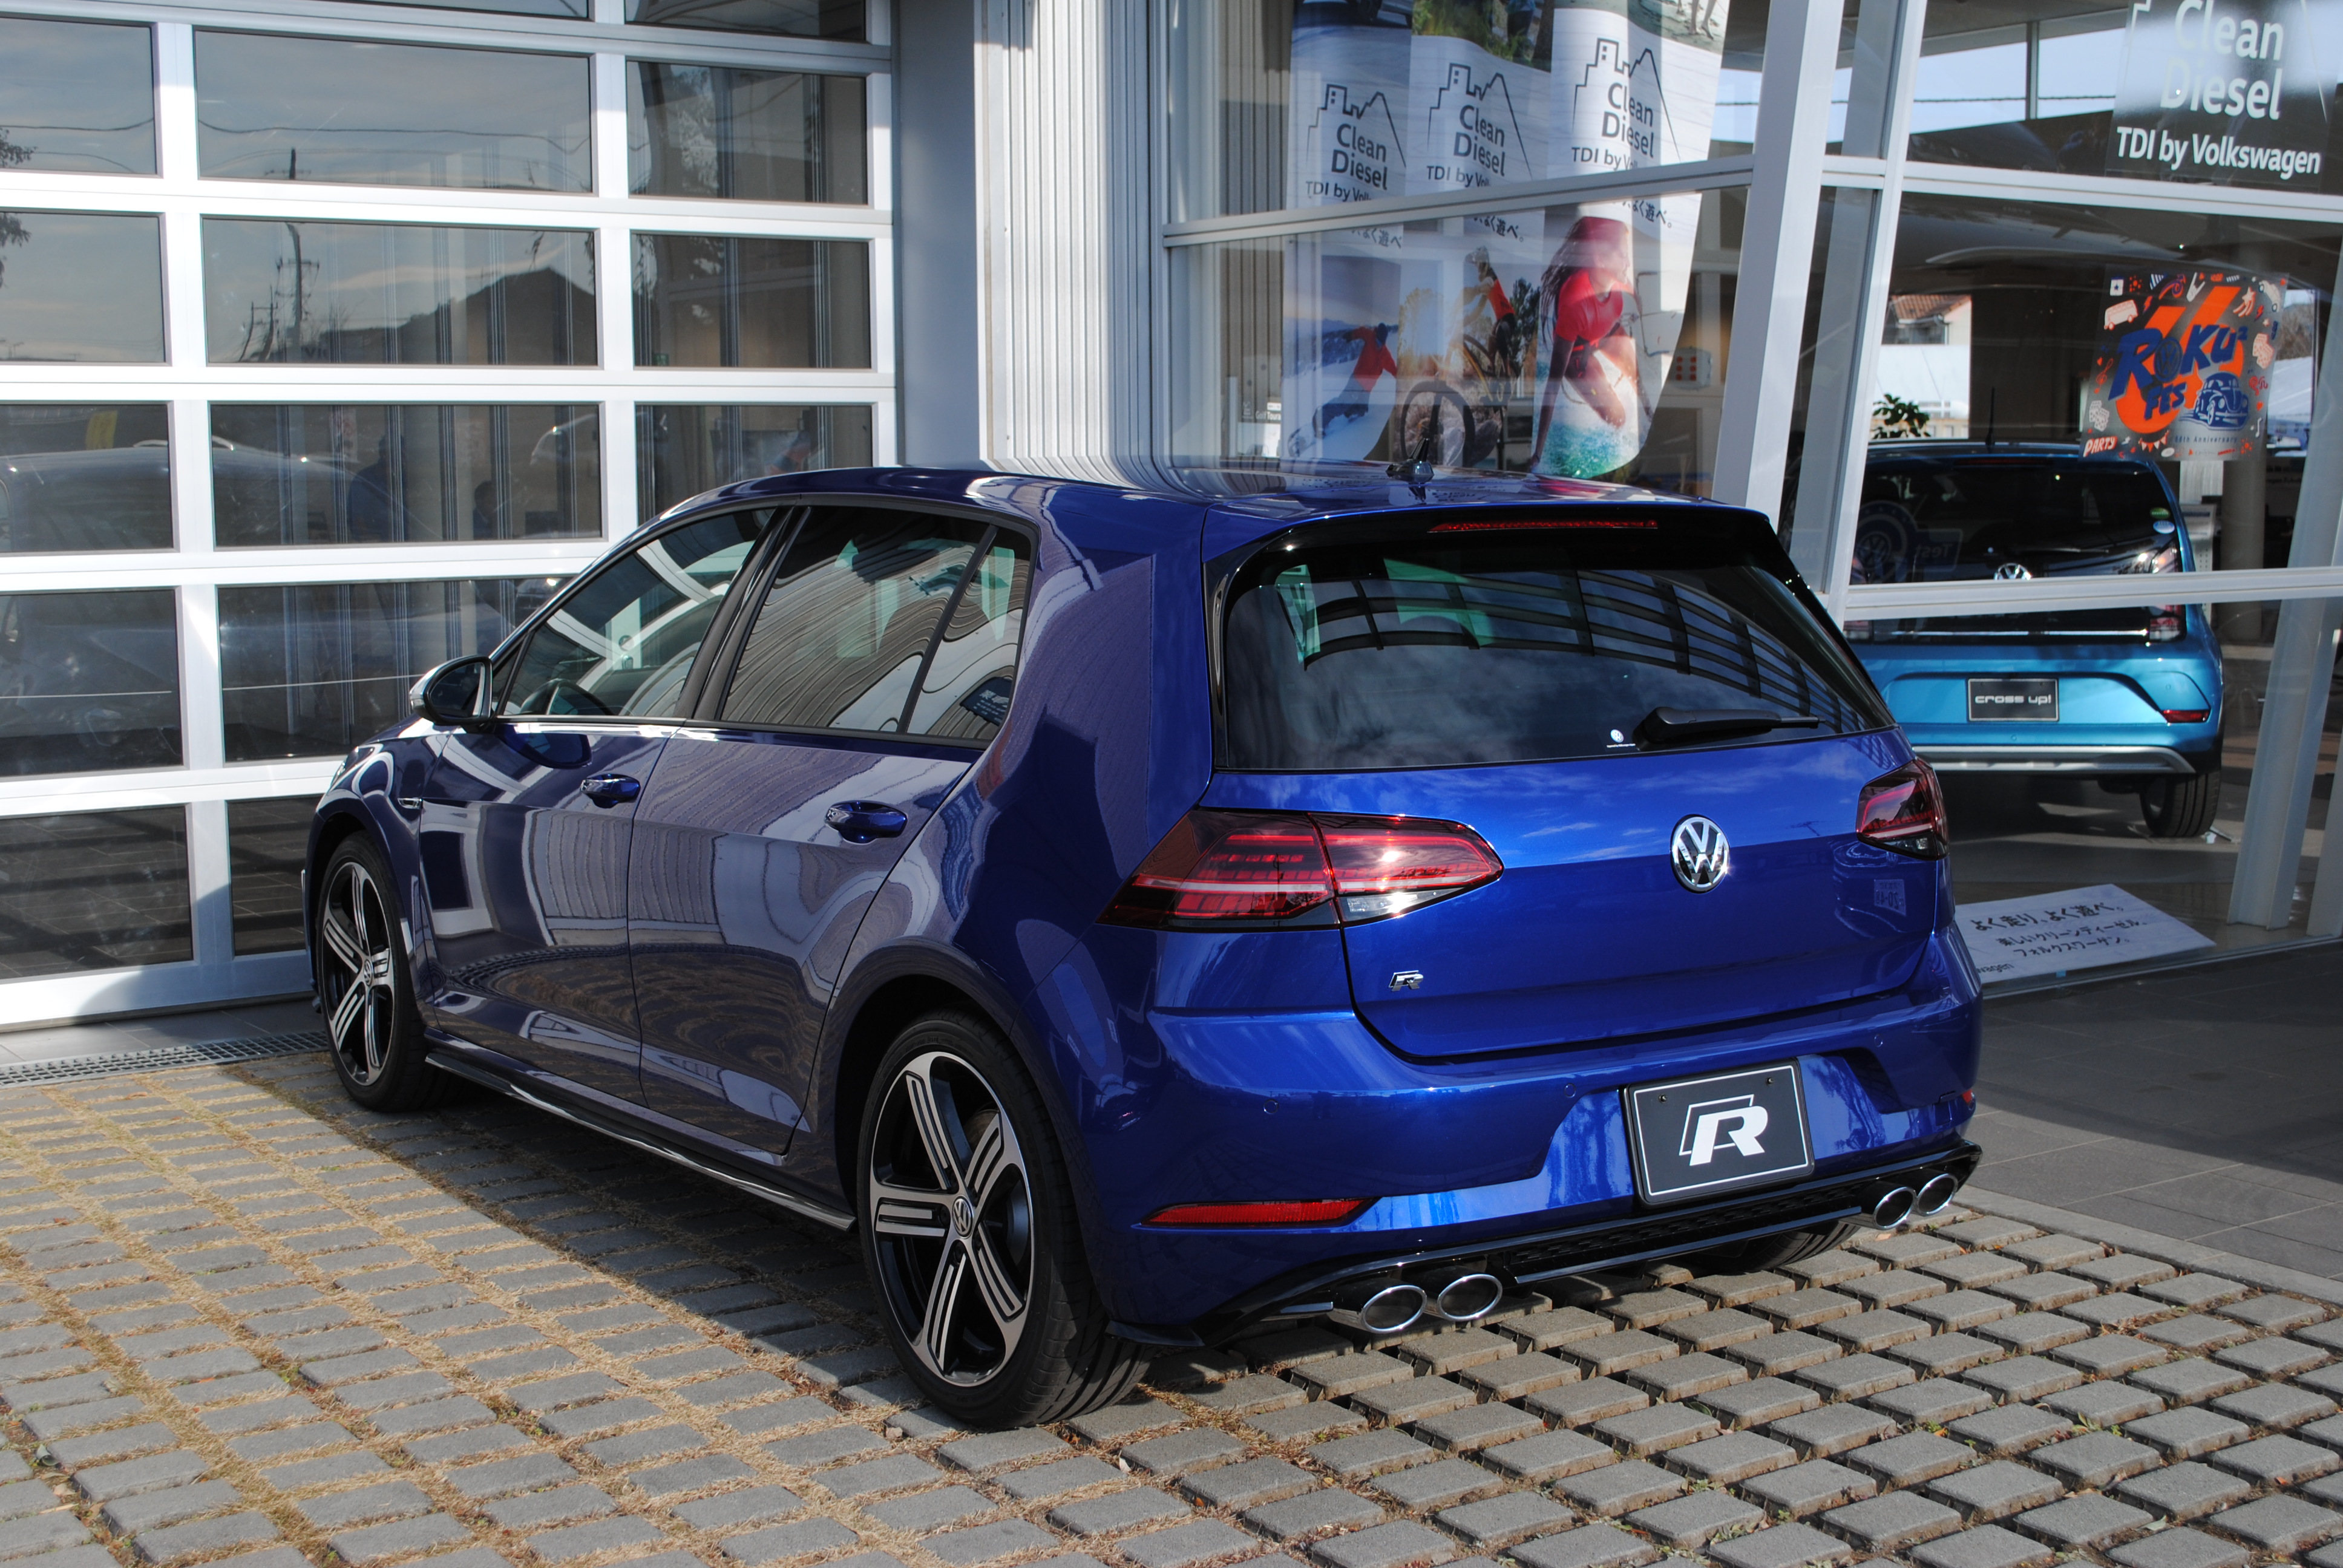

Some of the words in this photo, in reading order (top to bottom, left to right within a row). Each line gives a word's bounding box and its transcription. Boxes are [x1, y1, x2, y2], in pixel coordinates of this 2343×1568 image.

[2175, 0, 2284, 60] Clean
[1608, 82, 1653, 127] Clean
[2160, 57, 2282, 120] Diesel
[1337, 123, 1387, 163] Clean
[1460, 105, 1505, 147] Clean
[1601, 111, 1654, 158] Diesel
[1331, 149, 1388, 191] Diesel
[1453, 132, 1506, 177] Diesel
[1571, 147, 1599, 163] TDI
[1604, 149, 1622, 171] by
[2117, 126, 2155, 160] TDI
[2159, 131, 2188, 171] by
[2193, 134, 2321, 180] Volkswagen
[1305, 181, 1329, 195] TDI
[1334, 183, 1351, 202] by
[1426, 165, 1451, 181] TDI
[1456, 168, 1474, 188] by
[2083, 436, 2118, 458] PARTY
[1974, 694, 2025, 704] cross
[2028, 694, 2052, 705] up!
[1391, 972, 1424, 991] R
[1688, 1105, 1769, 1166] R
